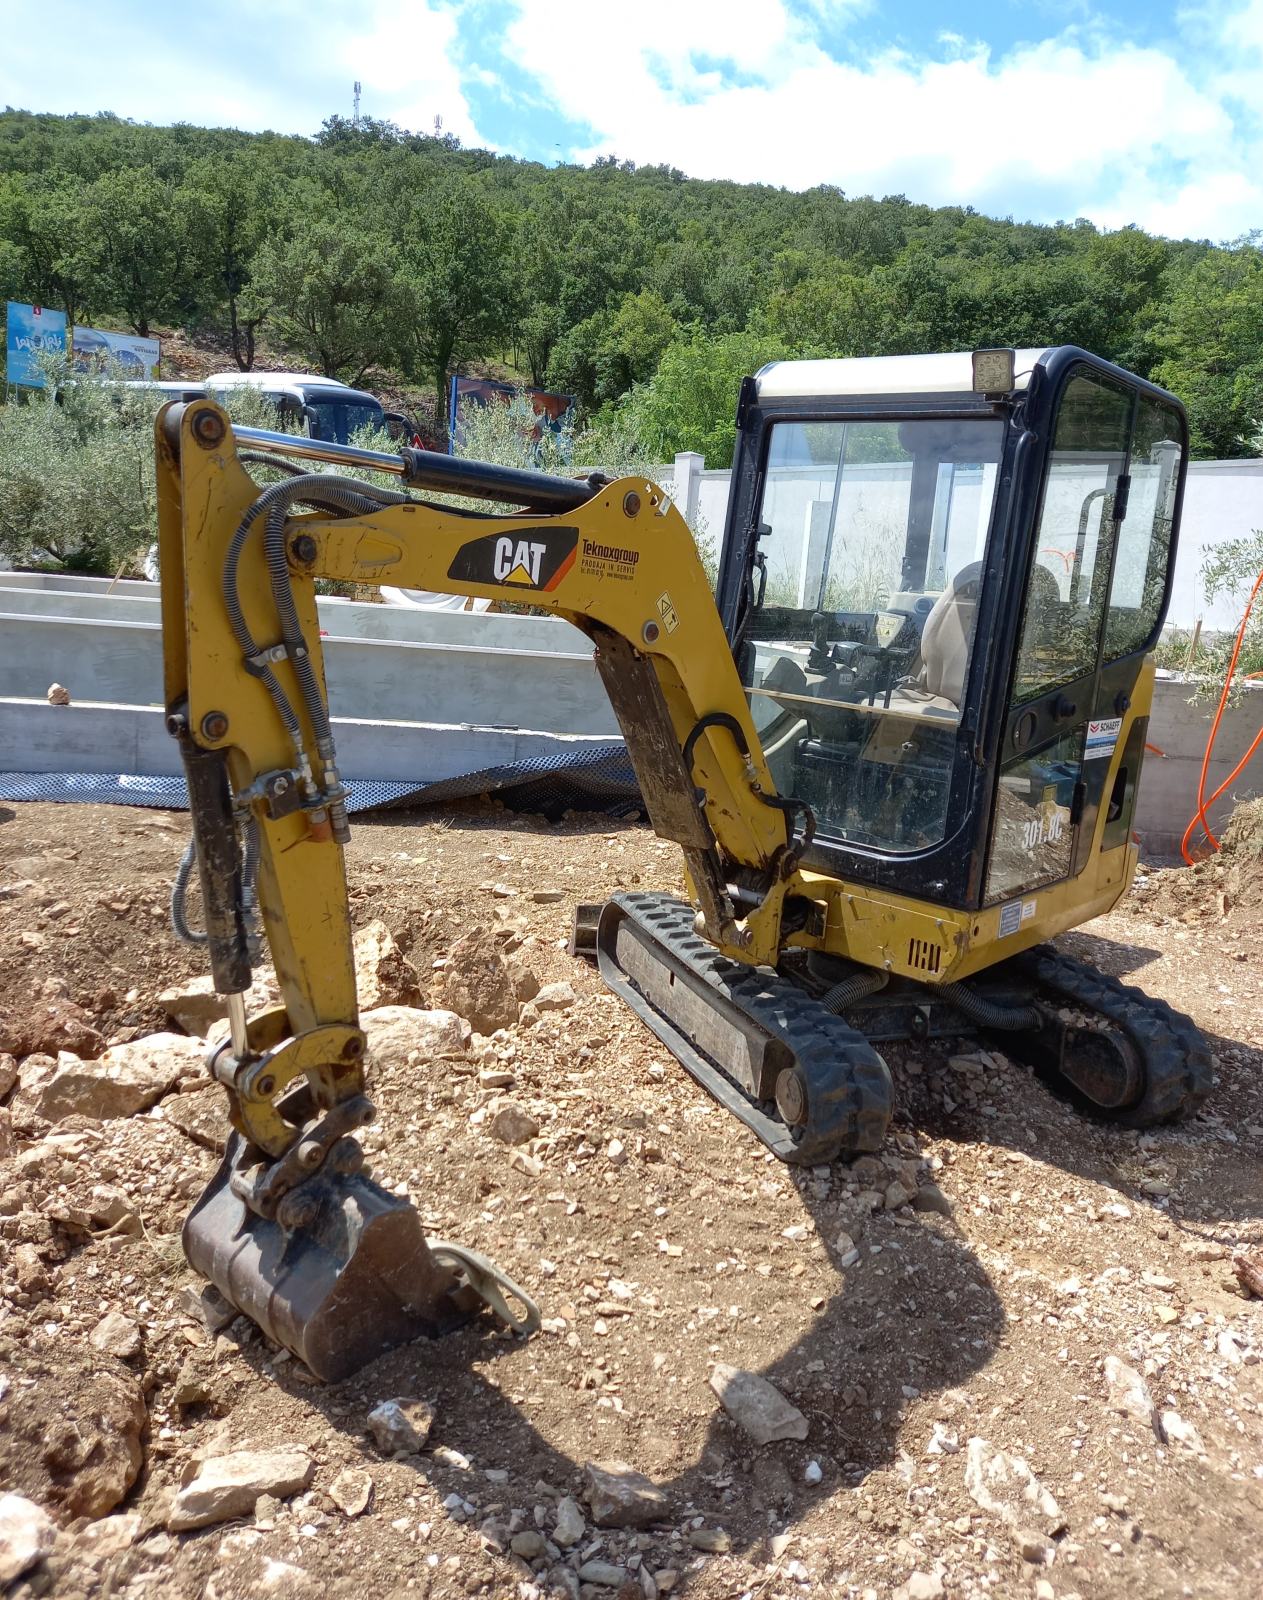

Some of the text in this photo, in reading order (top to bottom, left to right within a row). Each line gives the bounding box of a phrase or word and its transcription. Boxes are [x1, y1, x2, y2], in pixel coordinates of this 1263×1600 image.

[493, 536, 547, 586] CAT
[582, 538, 640, 566] Teknoxgroup
[1021, 812, 1064, 850] 301.8C
